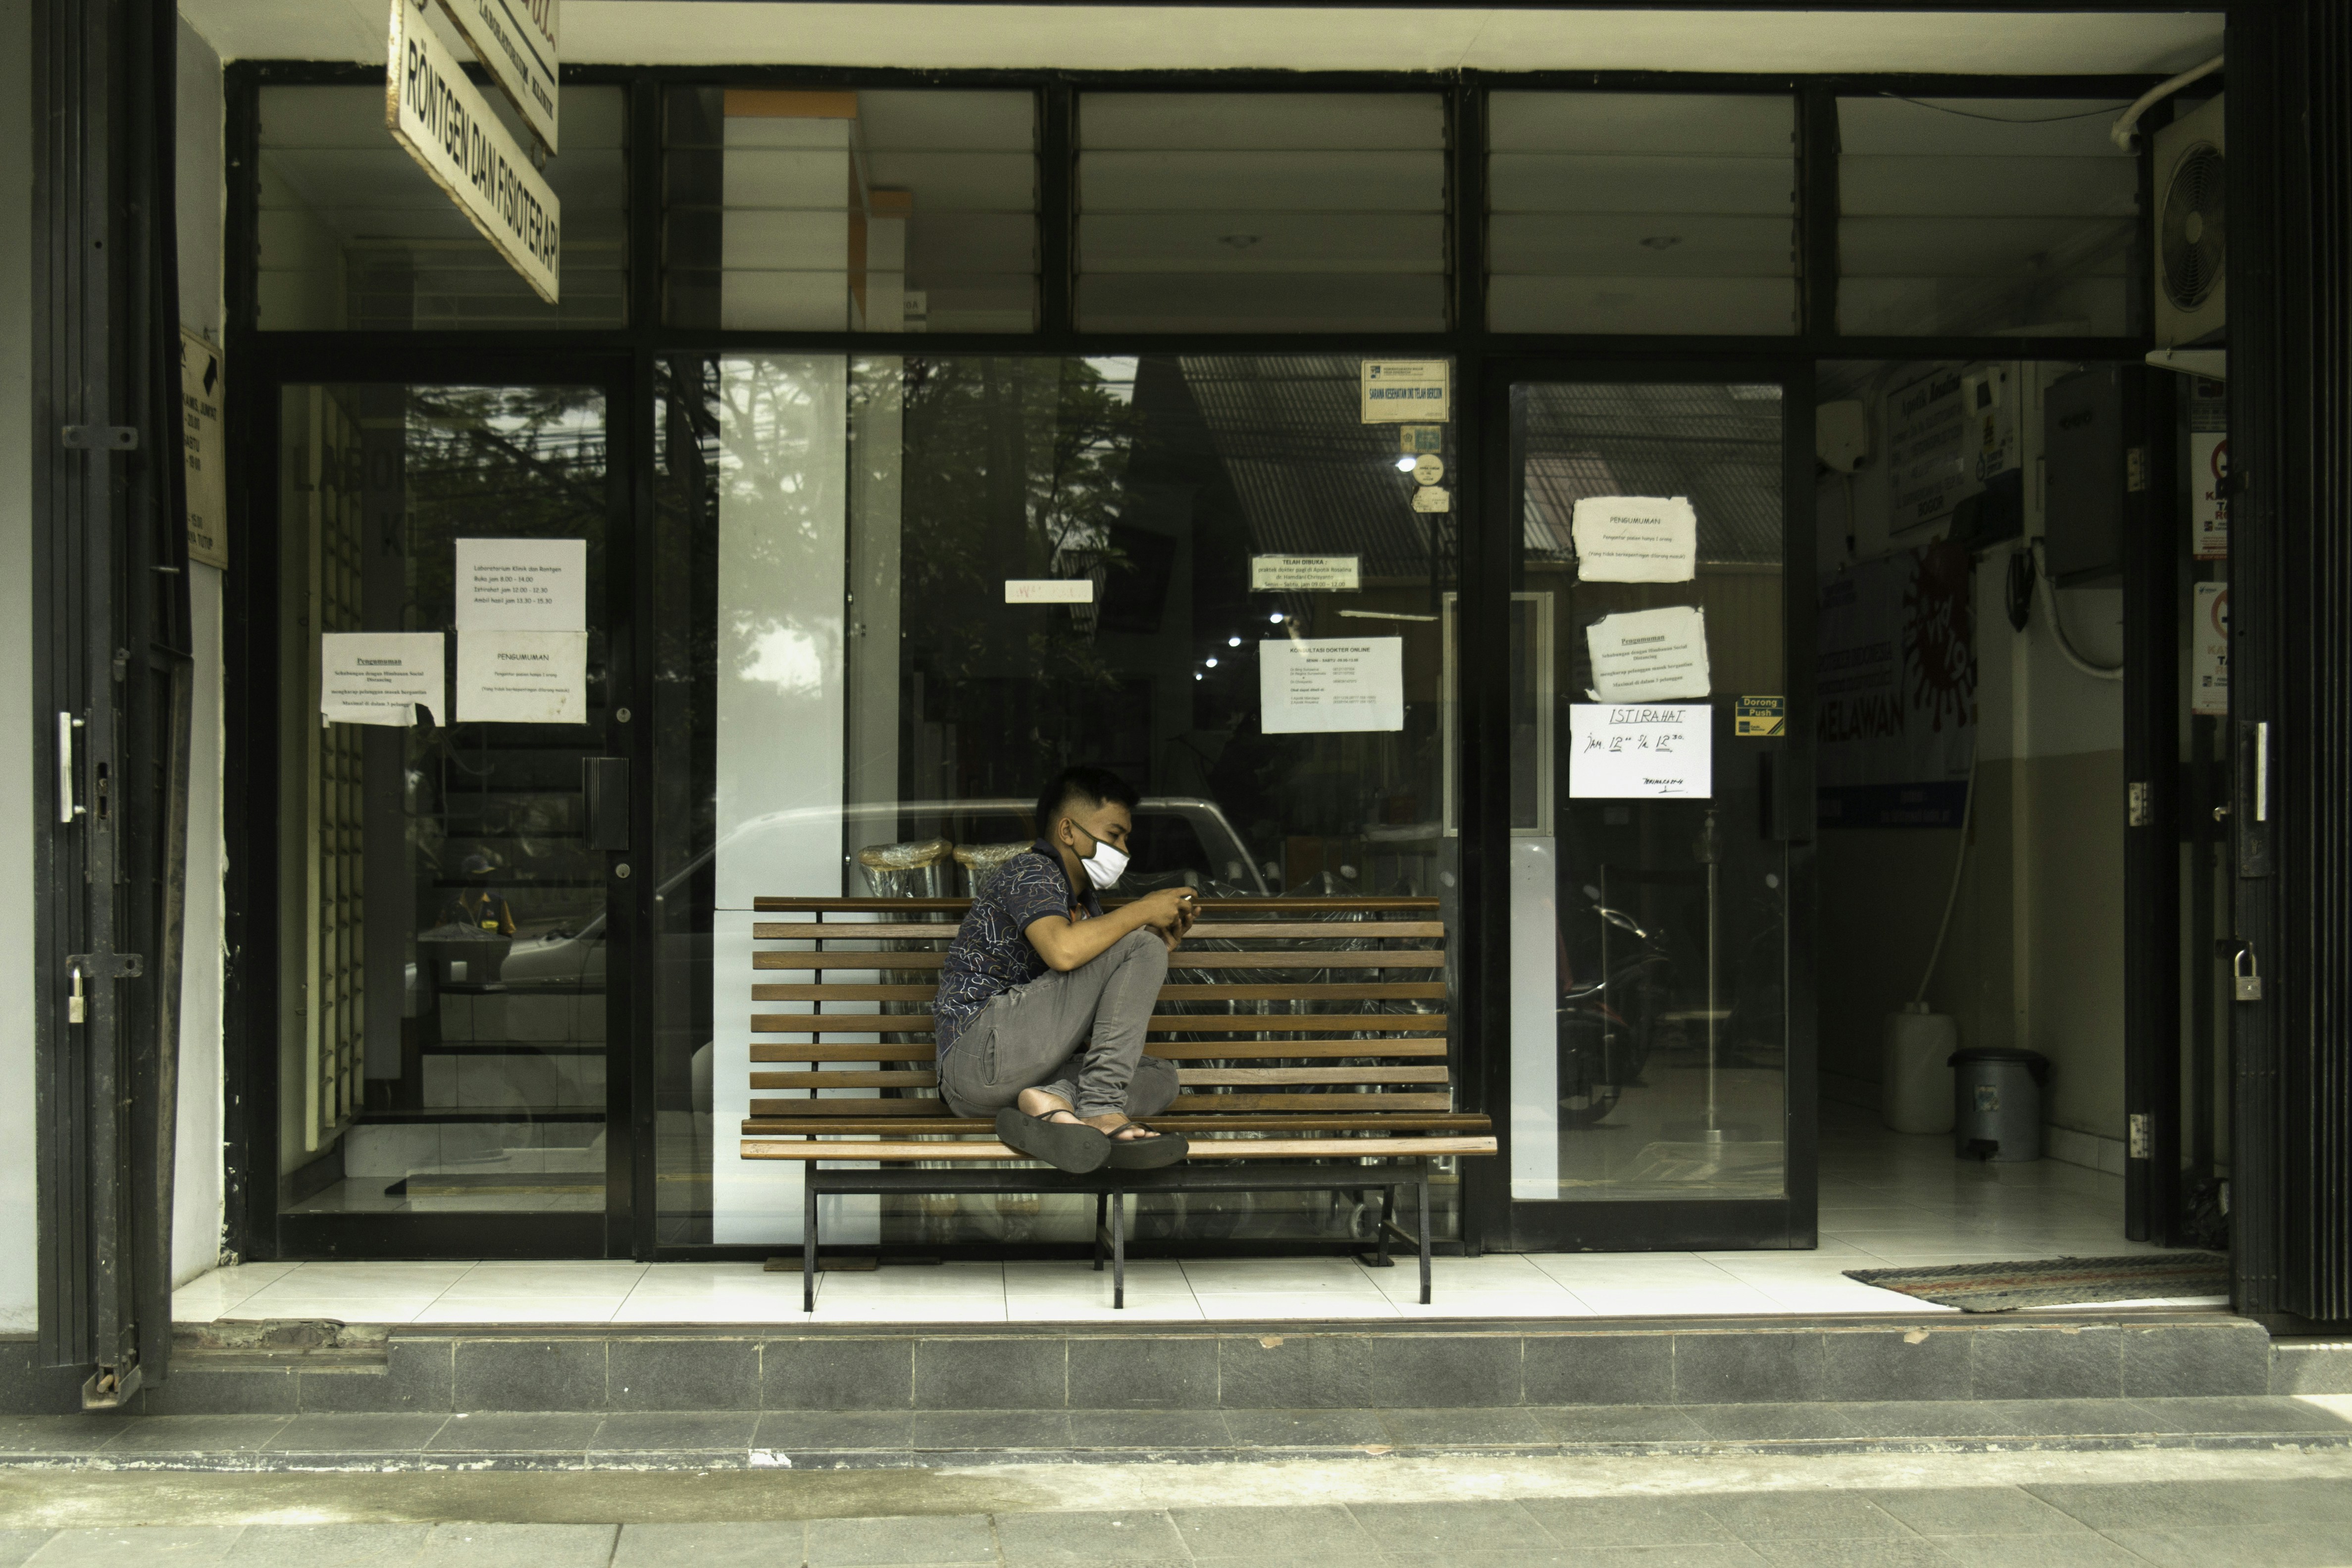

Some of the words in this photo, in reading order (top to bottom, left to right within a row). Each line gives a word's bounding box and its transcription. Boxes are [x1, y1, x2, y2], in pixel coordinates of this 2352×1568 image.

[407, 38, 469, 176] RÖNTGEN
[471, 122, 495, 207] DAN
[498, 154, 559, 280] FISIOTERAPI
[1621, 635, 1665, 645] Pengumuman
[357, 658, 403, 666] Pengumuman
[1743, 698, 1777, 708] Dorong
[1609, 709, 1686, 724] ISTIRAHAT
